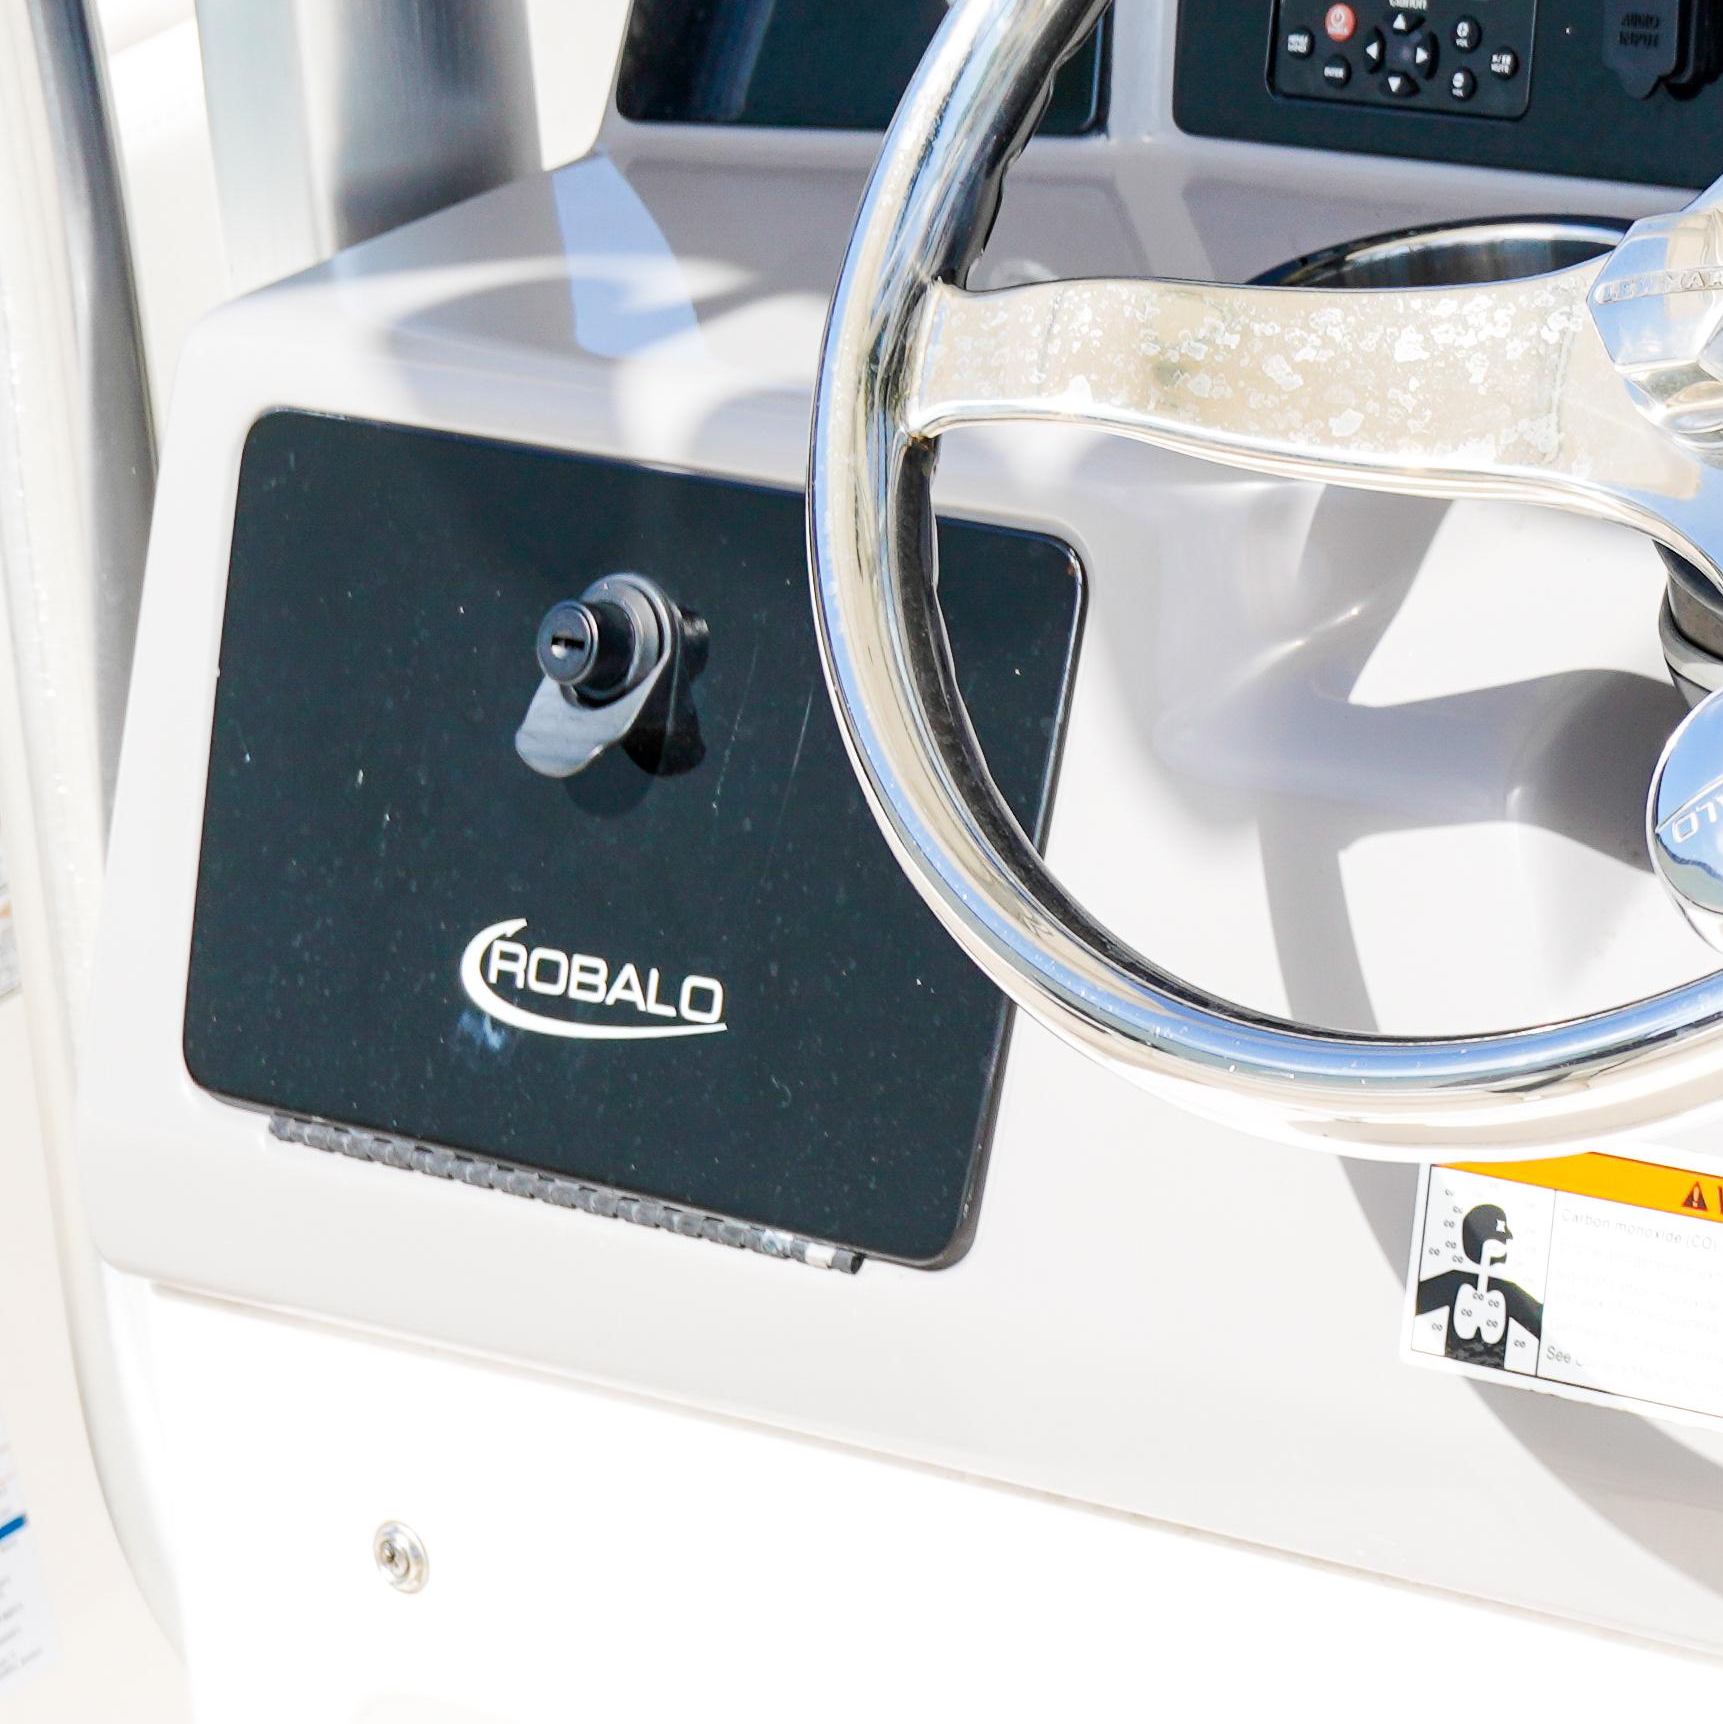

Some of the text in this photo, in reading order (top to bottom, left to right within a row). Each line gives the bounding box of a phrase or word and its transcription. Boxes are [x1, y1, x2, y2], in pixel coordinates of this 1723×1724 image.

[487, 938, 725, 1024] ROBALO
[1560, 1207, 1610, 1231] Carbon
[1614, 1217, 1683, 1245] monoxide
[1685, 1232, 1719, 1254] (CO)
[1545, 1343, 1572, 1365] See
